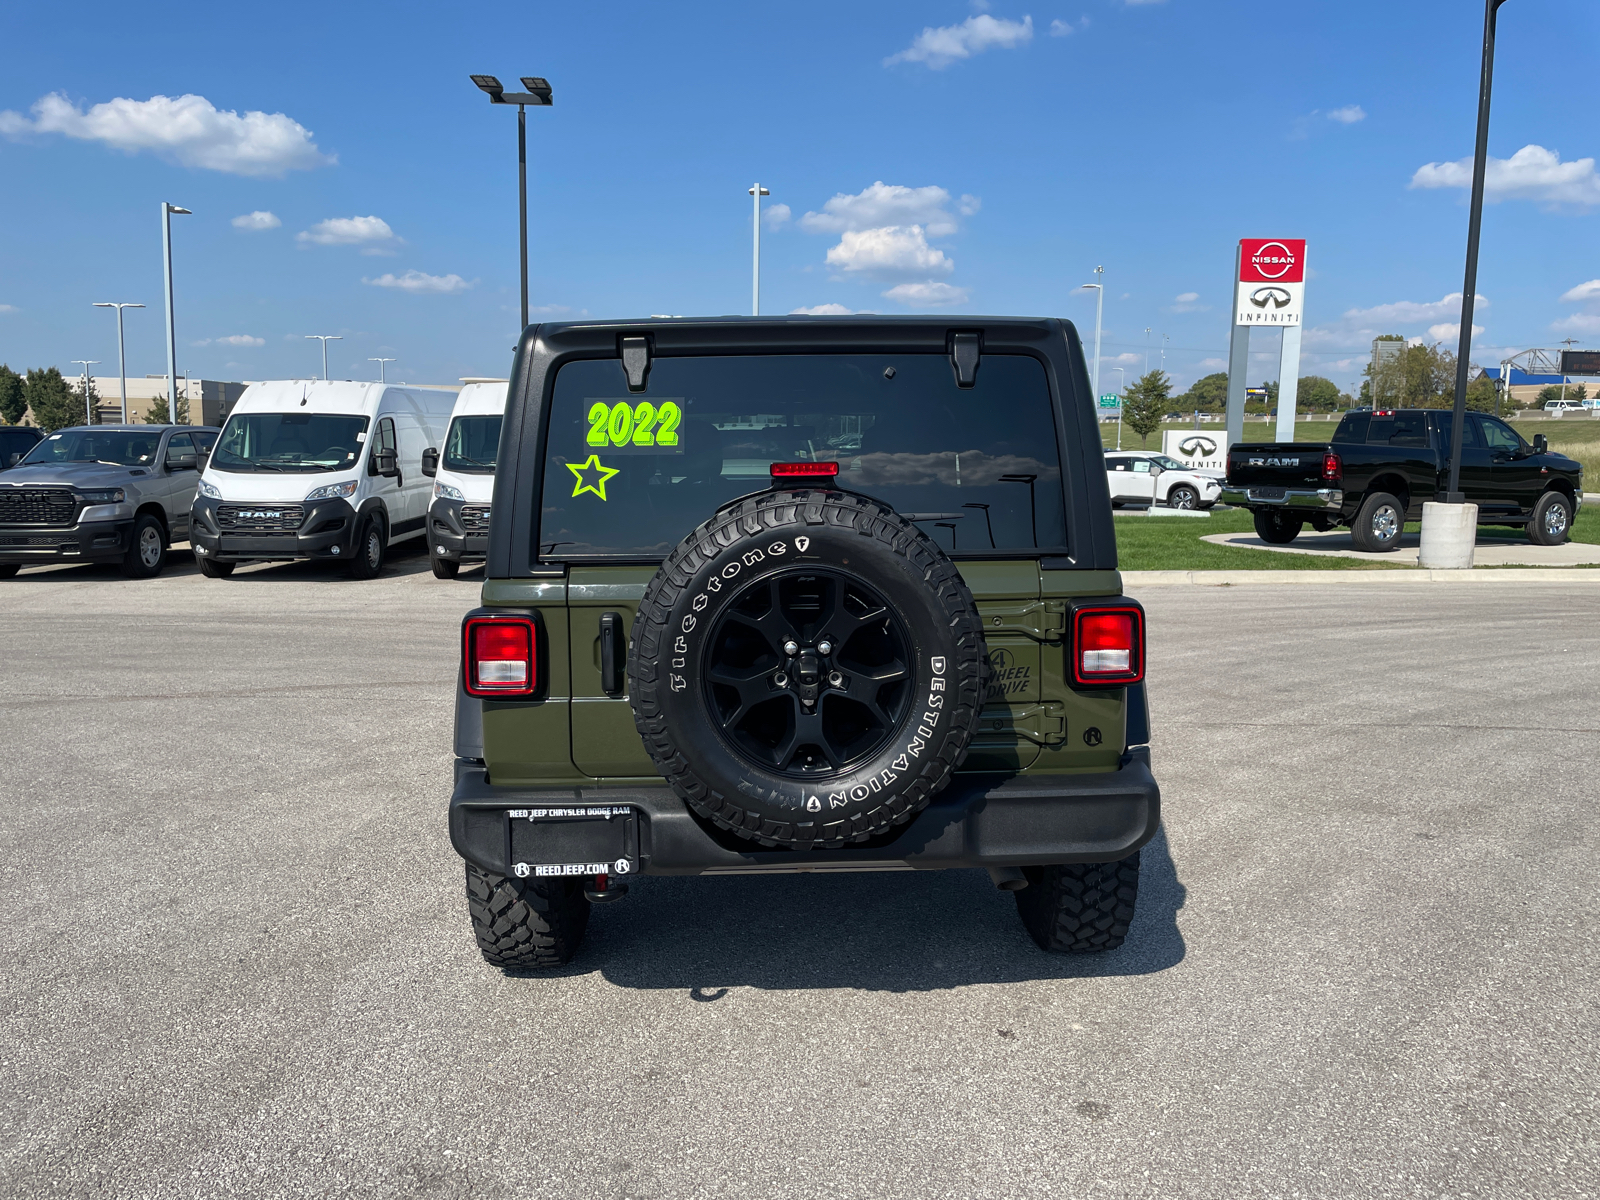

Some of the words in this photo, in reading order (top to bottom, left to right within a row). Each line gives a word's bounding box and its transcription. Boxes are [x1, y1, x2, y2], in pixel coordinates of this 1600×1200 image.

[1240, 313, 1299, 321] INFINITI
[586, 401, 682, 447] 2022
[1248, 457, 1299, 466] RAM
[670, 541, 787, 693] Firestone
[992, 651, 1005, 668] 4
[986, 680, 1030, 699] DRIVE
[829, 655, 946, 810] DESTINATION
[509, 810, 528, 818] REED
[530, 809, 547, 818] JEEP
[549, 808, 586, 817] CHRYSLER
[587, 807, 611, 816] DODGE
[613, 806, 630, 815] RAM
[536, 864, 609, 876] REEDJEEP.COM
